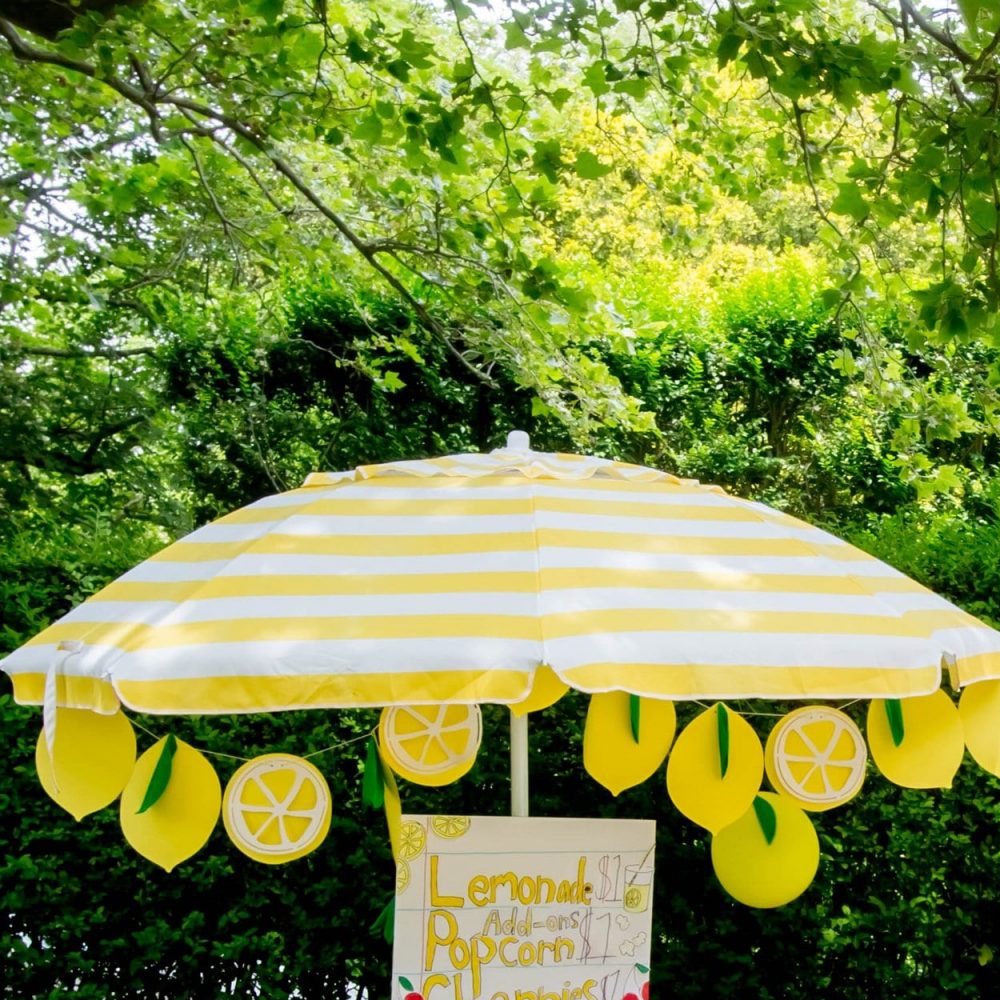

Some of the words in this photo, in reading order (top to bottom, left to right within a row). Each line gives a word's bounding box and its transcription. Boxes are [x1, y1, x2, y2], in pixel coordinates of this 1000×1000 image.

[430, 855, 592, 908] Lemonade
[595, 854, 622, 903] $1
[482, 907, 579, 937] Add-ons
[425, 909, 575, 998] Popcorn
[576, 907, 616, 965] $1
